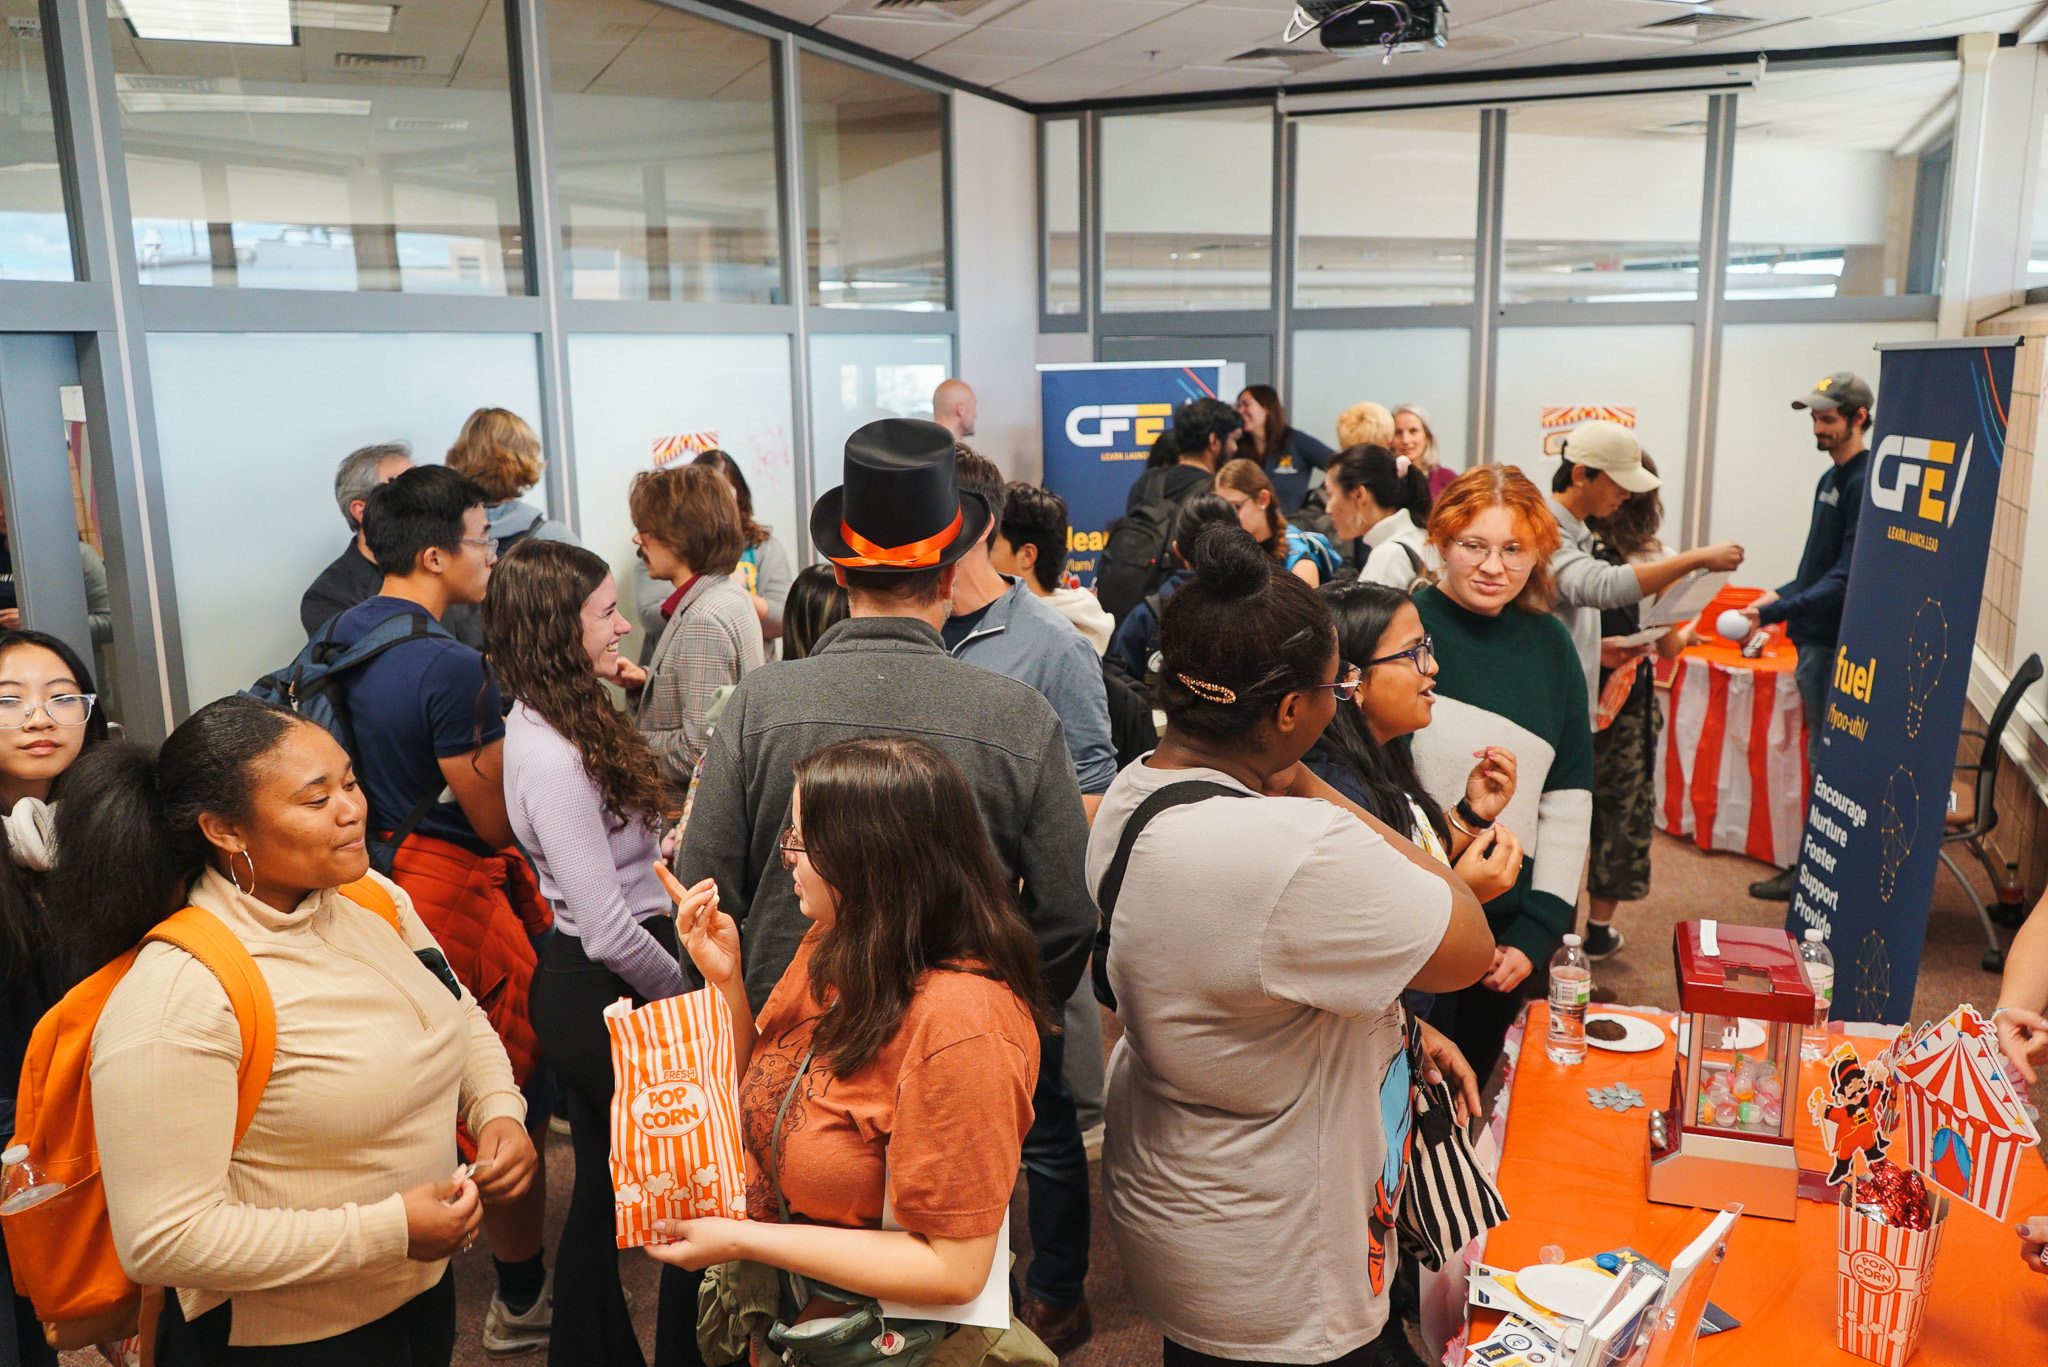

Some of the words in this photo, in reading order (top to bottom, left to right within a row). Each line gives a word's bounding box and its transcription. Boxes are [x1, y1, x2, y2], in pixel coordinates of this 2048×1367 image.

[1065, 403, 1172, 447] CFE
[1870, 434, 1956, 522] CFE
[1834, 645, 1877, 704] fuel
[1814, 773, 1867, 827] Encourage
[1809, 804, 1848, 848] Nurture
[1804, 837, 1837, 873] Foster
[1799, 864, 1839, 911] Support
[1794, 892, 1832, 940] Provide
[663, 1068, 695, 1080] FRESH
[641, 1103, 700, 1130] CORN
[648, 1086, 687, 1110] POP
[1856, 1264, 1891, 1284] CORN
[1861, 1256, 1887, 1272] POP
